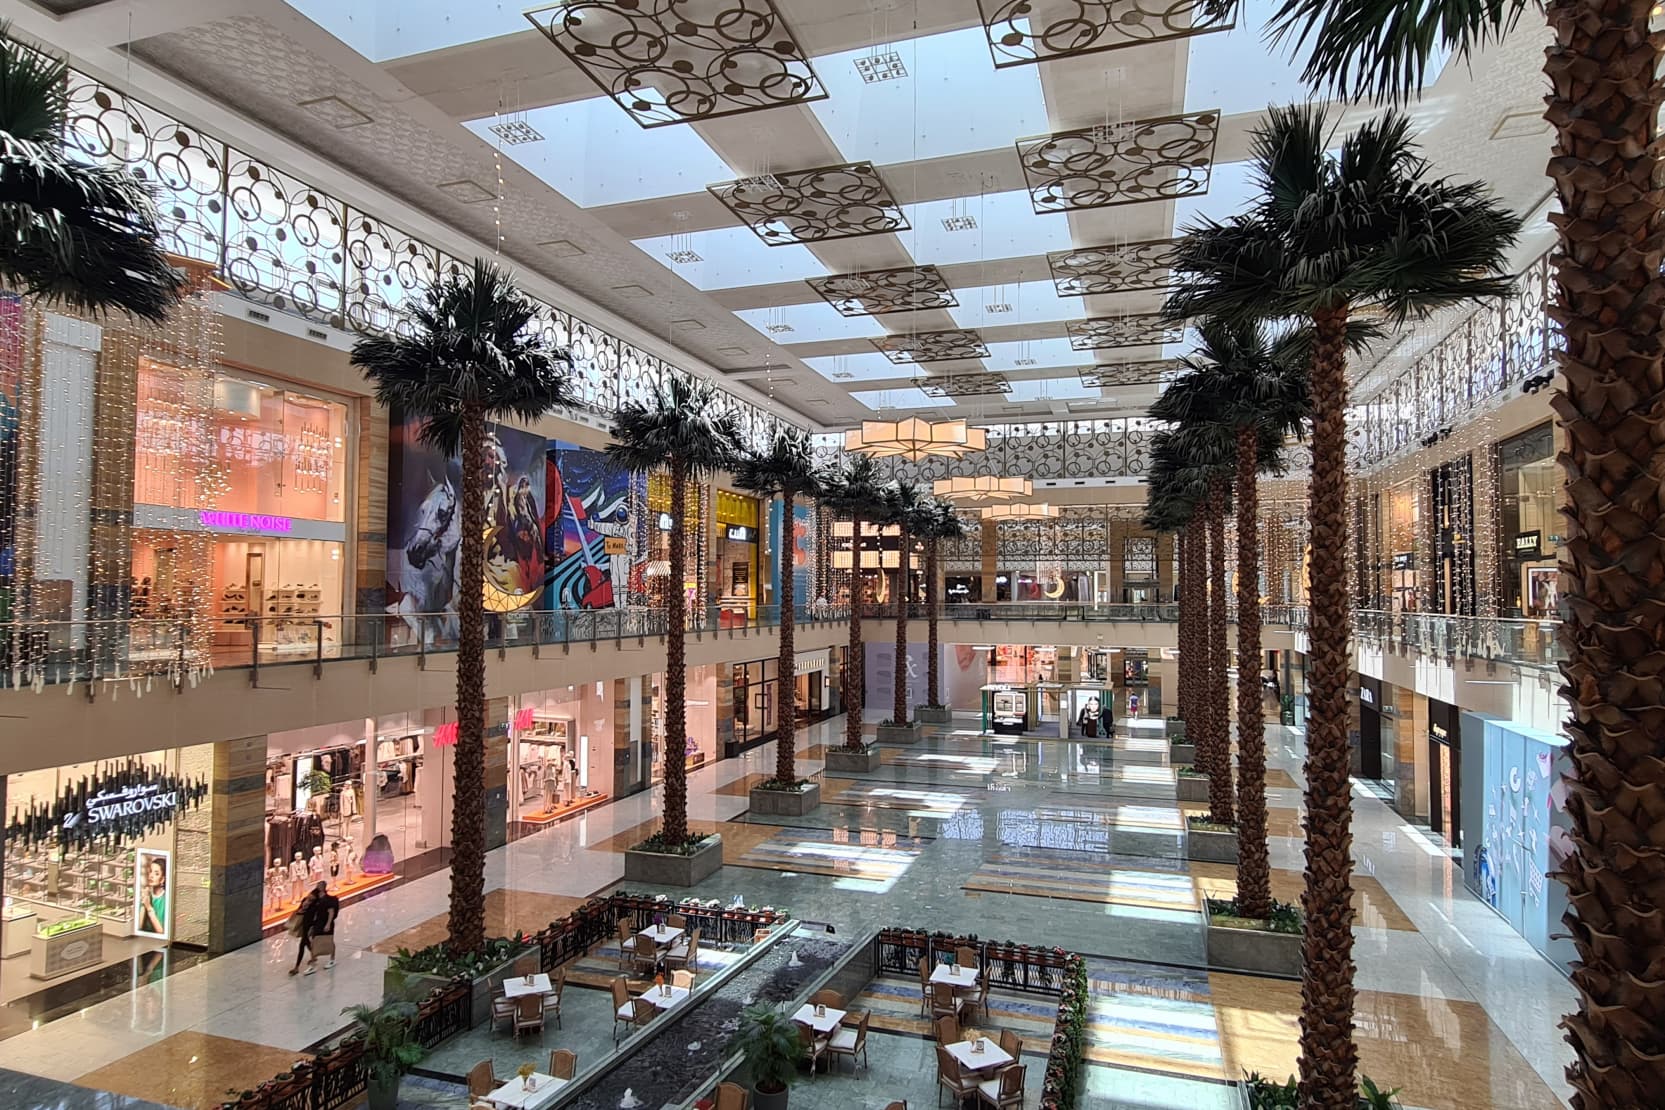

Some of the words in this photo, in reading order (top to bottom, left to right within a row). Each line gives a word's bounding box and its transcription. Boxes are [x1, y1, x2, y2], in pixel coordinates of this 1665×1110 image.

[200, 510, 248, 529] WHITE
[250, 514, 292, 531] NOISE
[1516, 535, 1538, 549] BALLY
[1360, 686, 1373, 704] ZARA
[88, 791, 177, 824] SWAROVSKI
